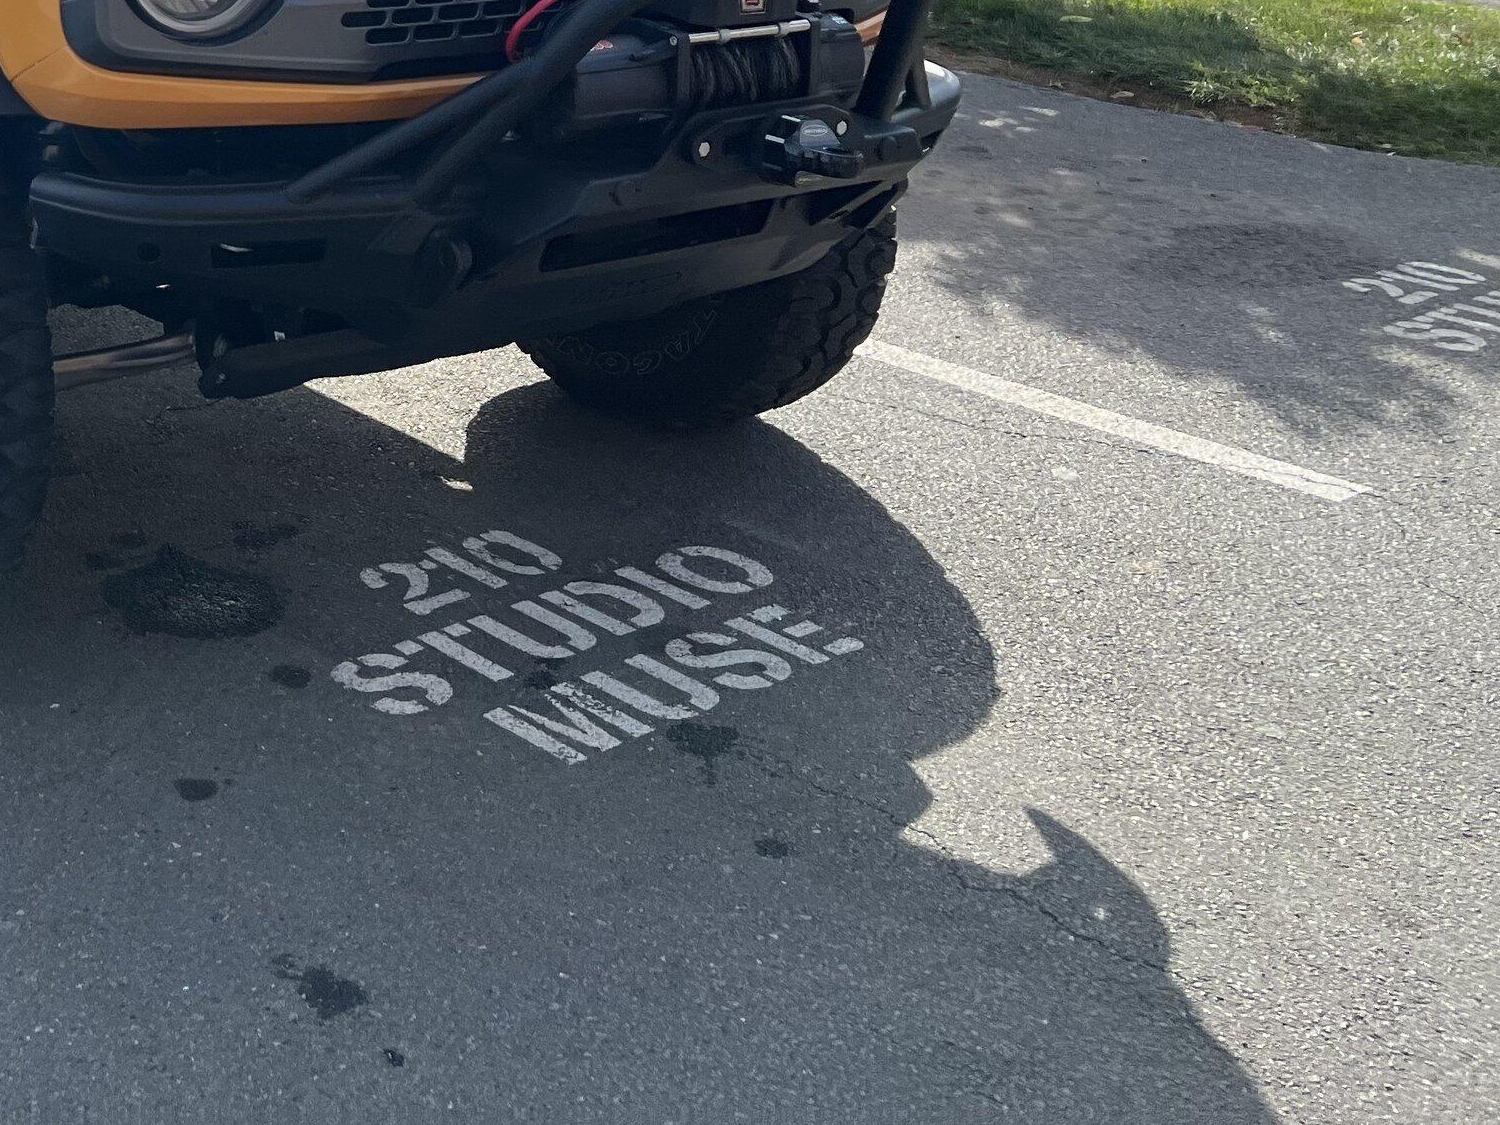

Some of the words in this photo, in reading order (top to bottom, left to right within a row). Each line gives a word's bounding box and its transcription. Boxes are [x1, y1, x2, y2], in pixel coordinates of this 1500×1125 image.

[1341, 261, 1487, 305] 210
[330, 545, 774, 716] STUDIO
[359, 529, 563, 616] 210
[483, 603, 865, 765] MUSE
